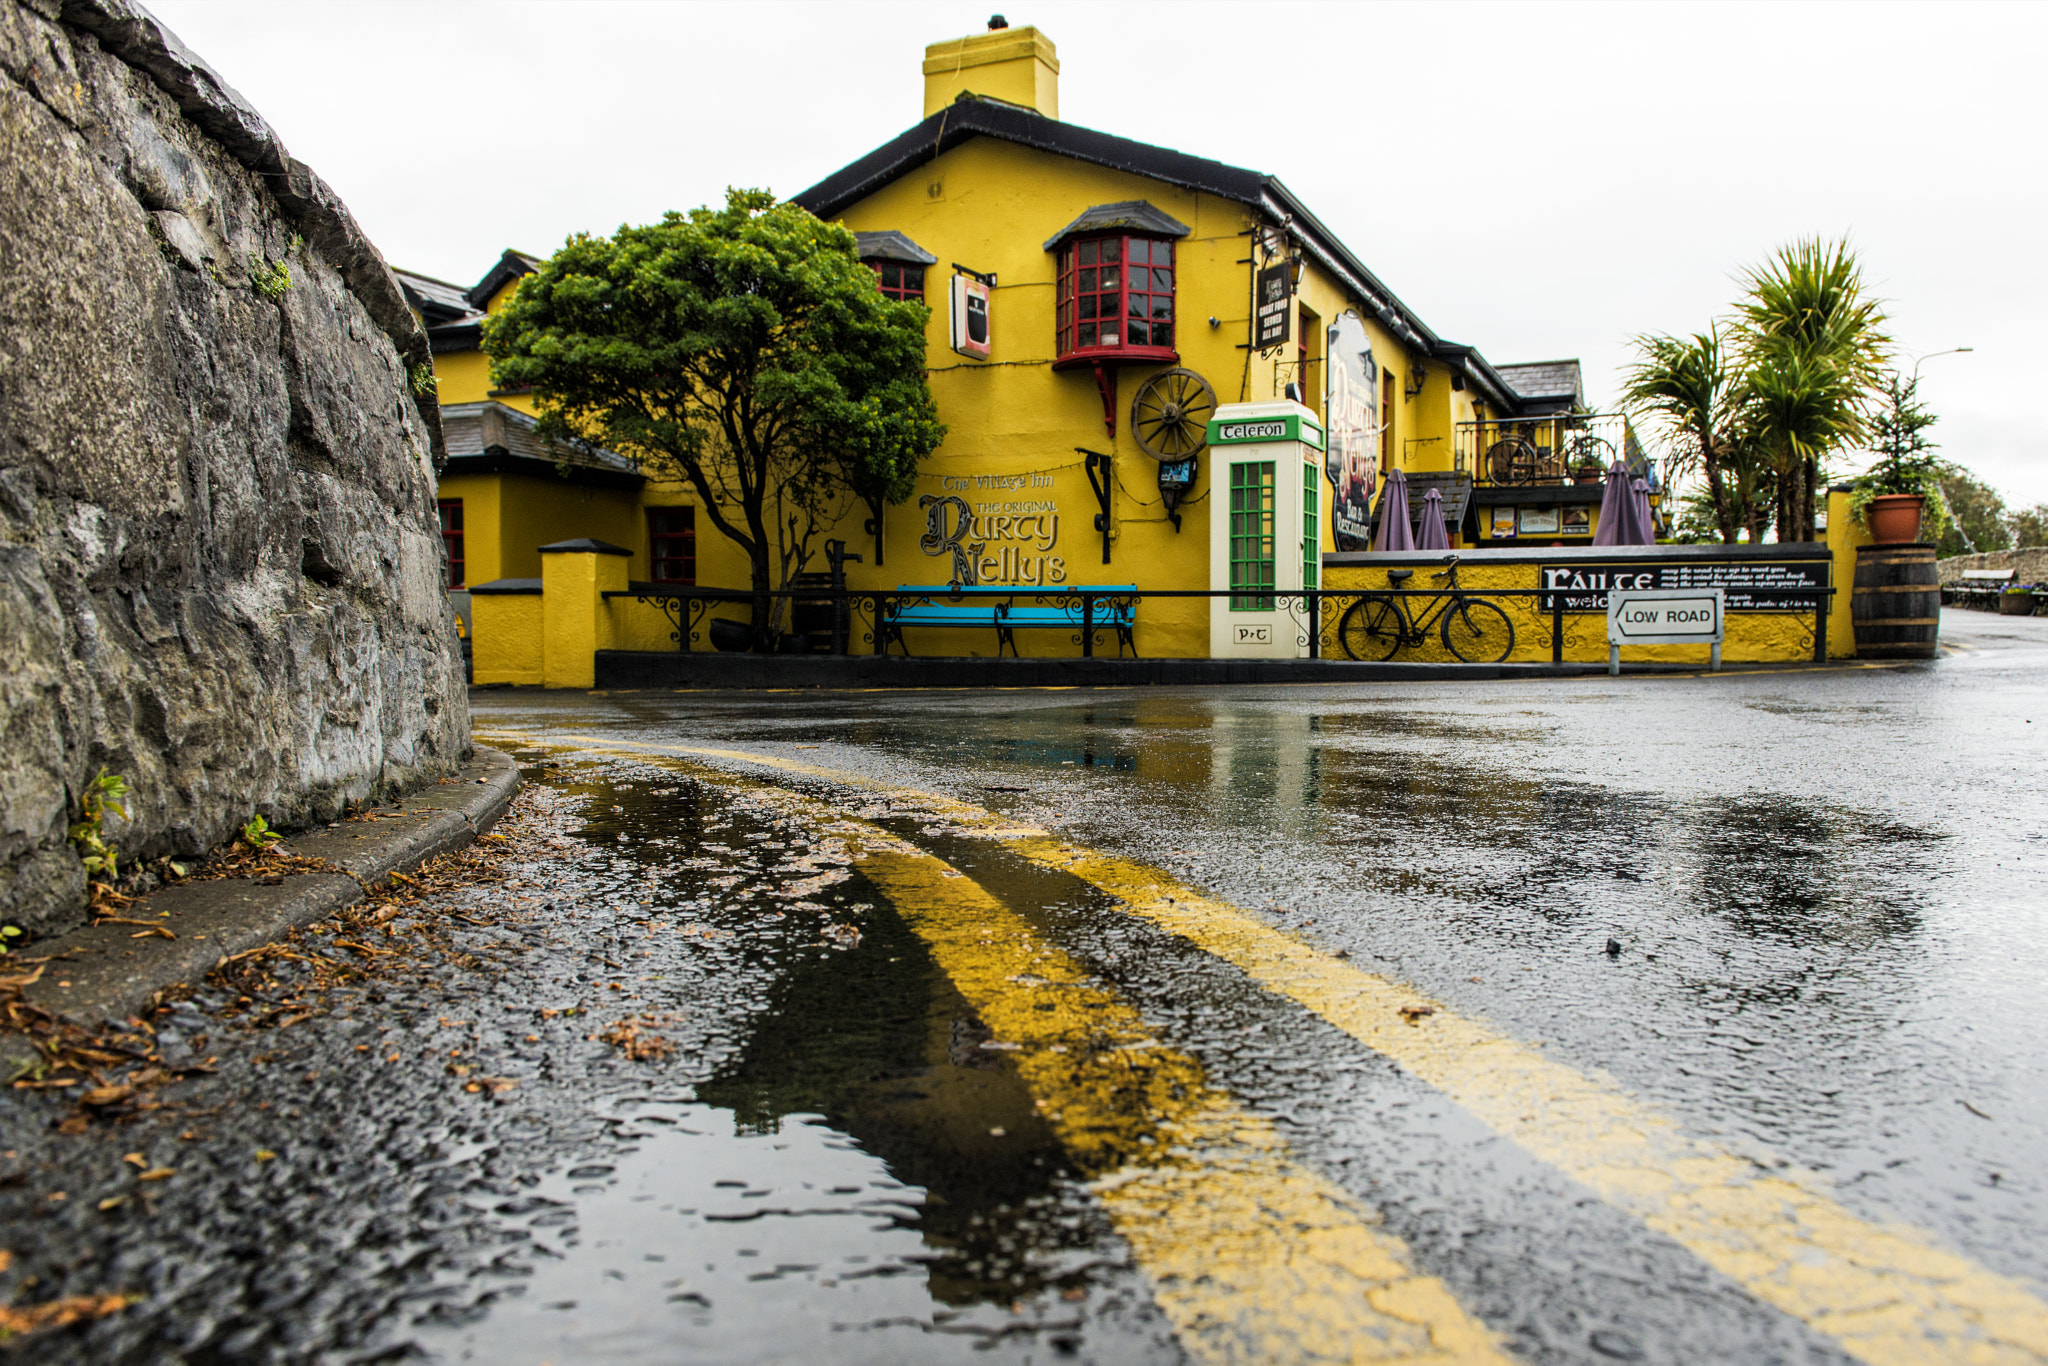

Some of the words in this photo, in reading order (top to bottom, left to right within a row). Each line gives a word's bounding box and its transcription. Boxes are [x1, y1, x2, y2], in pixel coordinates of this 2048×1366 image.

[974, 474, 1026, 492] Village
[1030, 473, 1054, 488] Inn
[976, 502, 1001, 514] THE
[1004, 501, 1058, 514] ORIGINAL
[1680, 566, 1692, 574] the
[1797, 579, 1816, 588] face
[1625, 611, 1659, 623] LOW
[1667, 610, 1710, 622] ROAD
